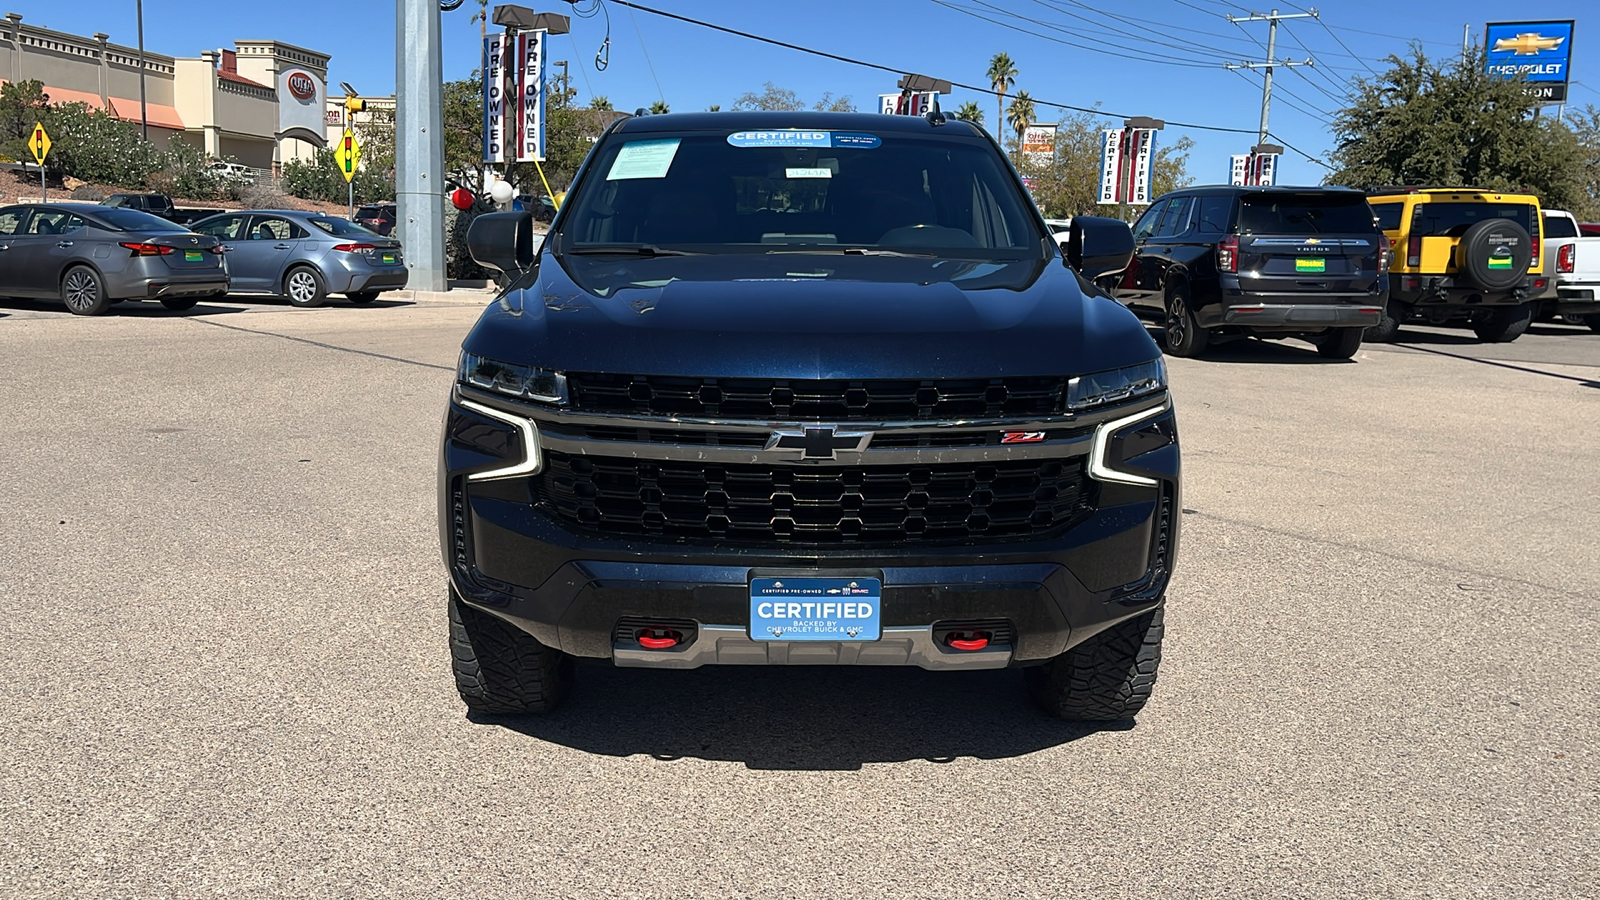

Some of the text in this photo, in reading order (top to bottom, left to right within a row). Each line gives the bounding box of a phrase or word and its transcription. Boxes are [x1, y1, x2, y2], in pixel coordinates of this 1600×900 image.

[489, 41, 500, 154] PRE OWNED
[525, 39, 538, 153] PRE OWNED
[733, 132, 825, 140] CERTIFIED
[1104, 132, 1117, 200] CERTIFIED
[1137, 132, 1149, 200] CERTIFIED
[758, 603, 873, 618] CERTIFIED
